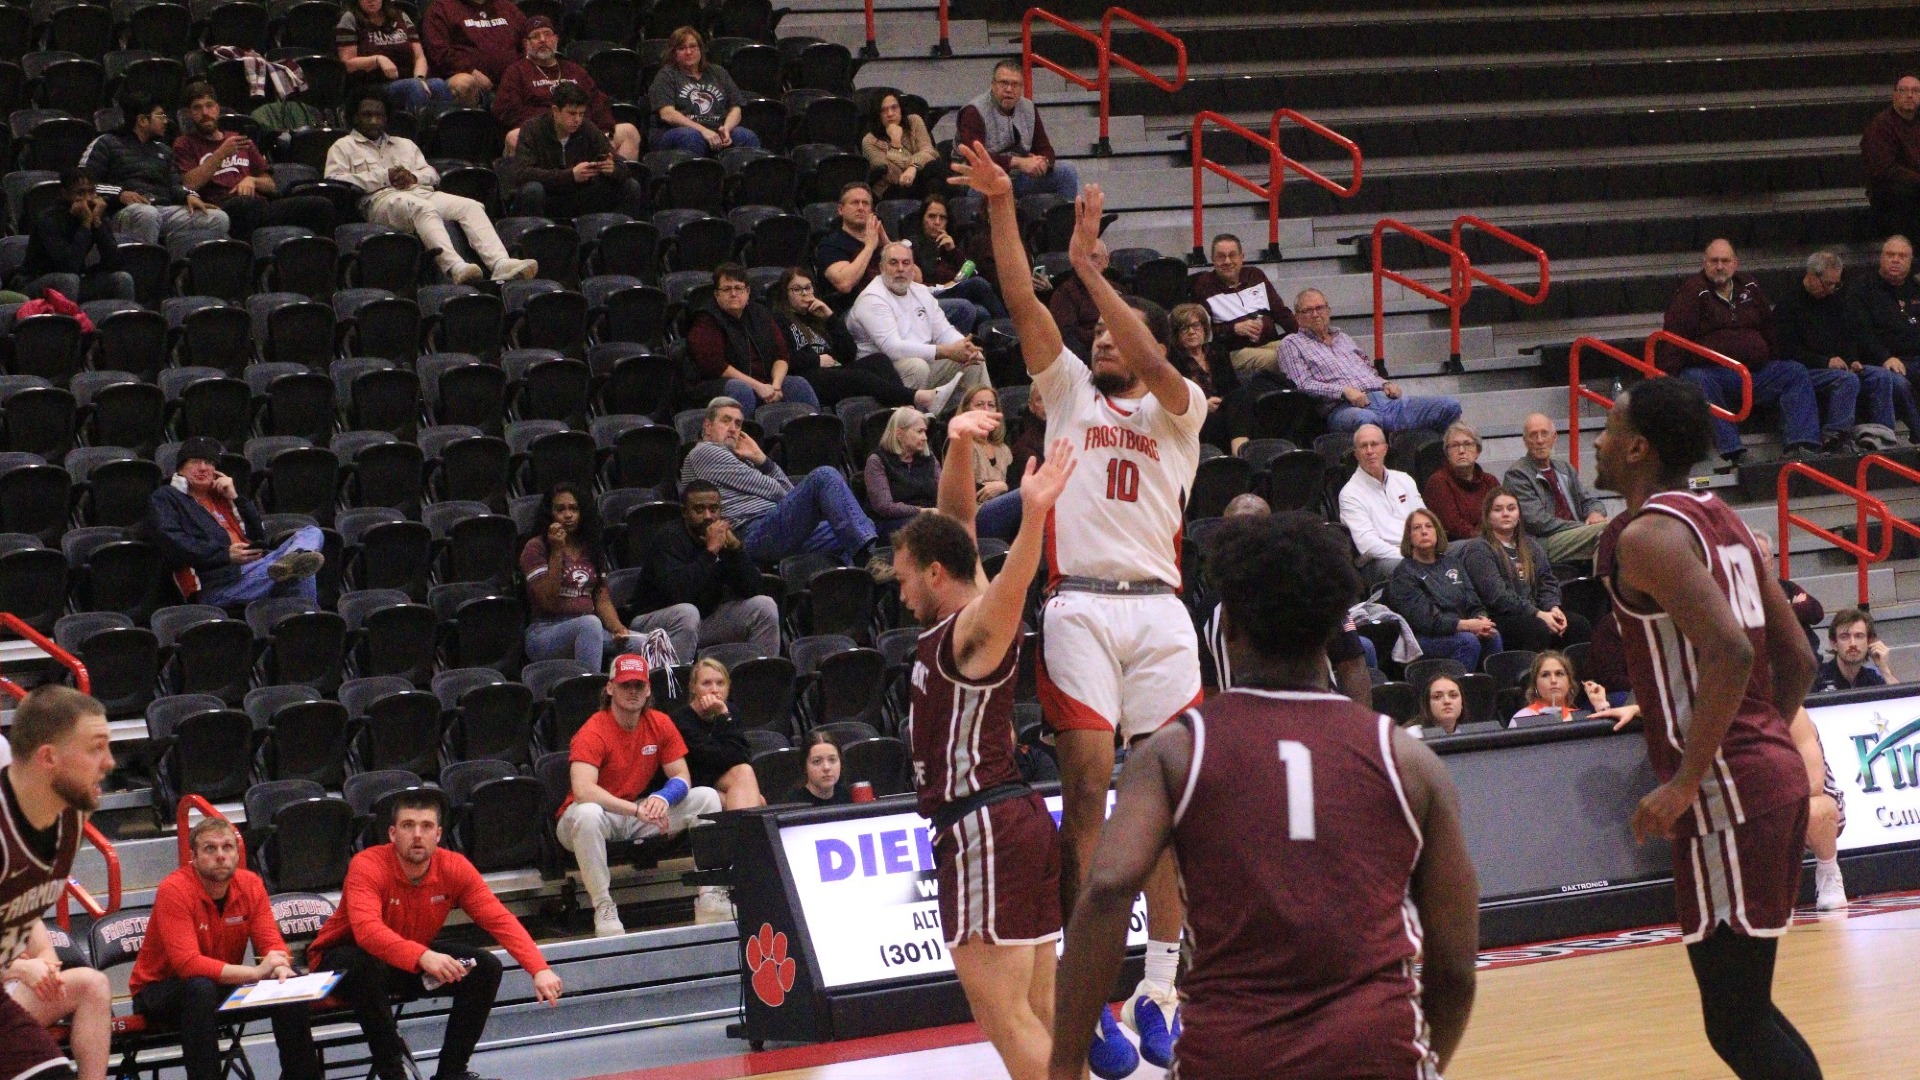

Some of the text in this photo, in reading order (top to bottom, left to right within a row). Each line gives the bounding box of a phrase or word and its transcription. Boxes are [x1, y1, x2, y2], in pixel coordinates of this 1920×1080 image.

[1084, 425, 1160, 462] FROSTBURG
[1106, 458, 1139, 503] 10
[1277, 740, 1316, 841] 1
[1561, 880, 1609, 892] DAKTRONICS
[279, 916, 322, 935] STATE
[880, 938, 942, 968] (301)
